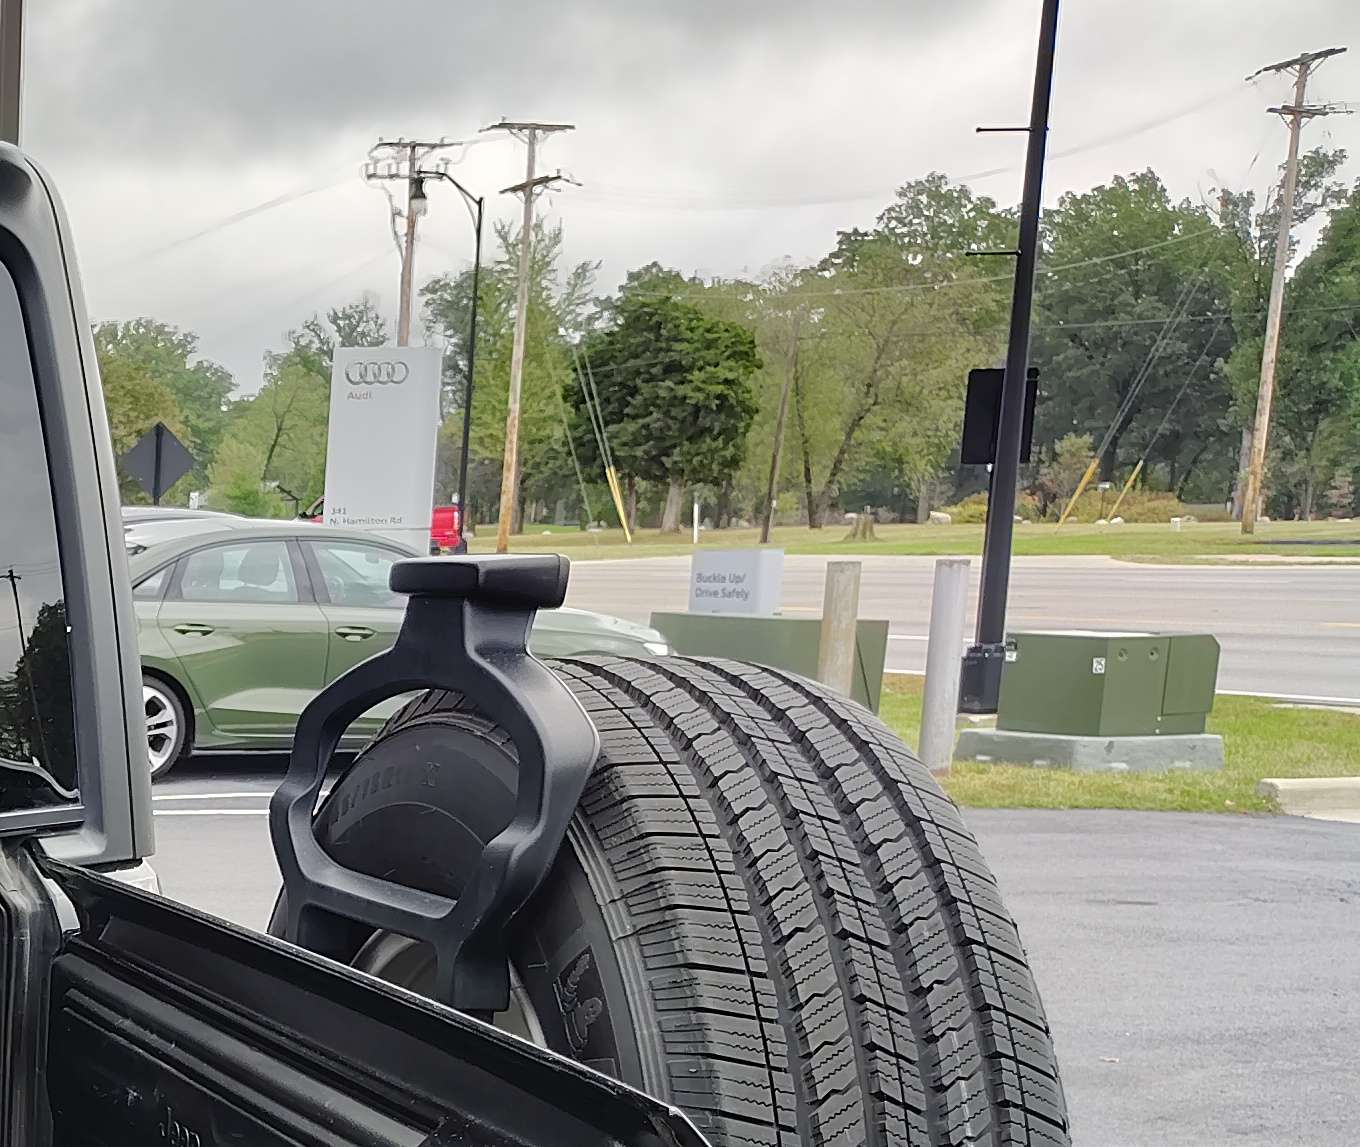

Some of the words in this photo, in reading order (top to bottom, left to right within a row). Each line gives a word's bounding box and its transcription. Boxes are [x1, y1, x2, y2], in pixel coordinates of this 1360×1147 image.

[346, 390, 373, 401] Audi
[342, 516, 387, 526] Hamilton
[389, 516, 403, 525] Rd
[695, 572, 727, 584] Buckle
[694, 586, 720, 598] Drive
[720, 586, 750, 601] Safety
